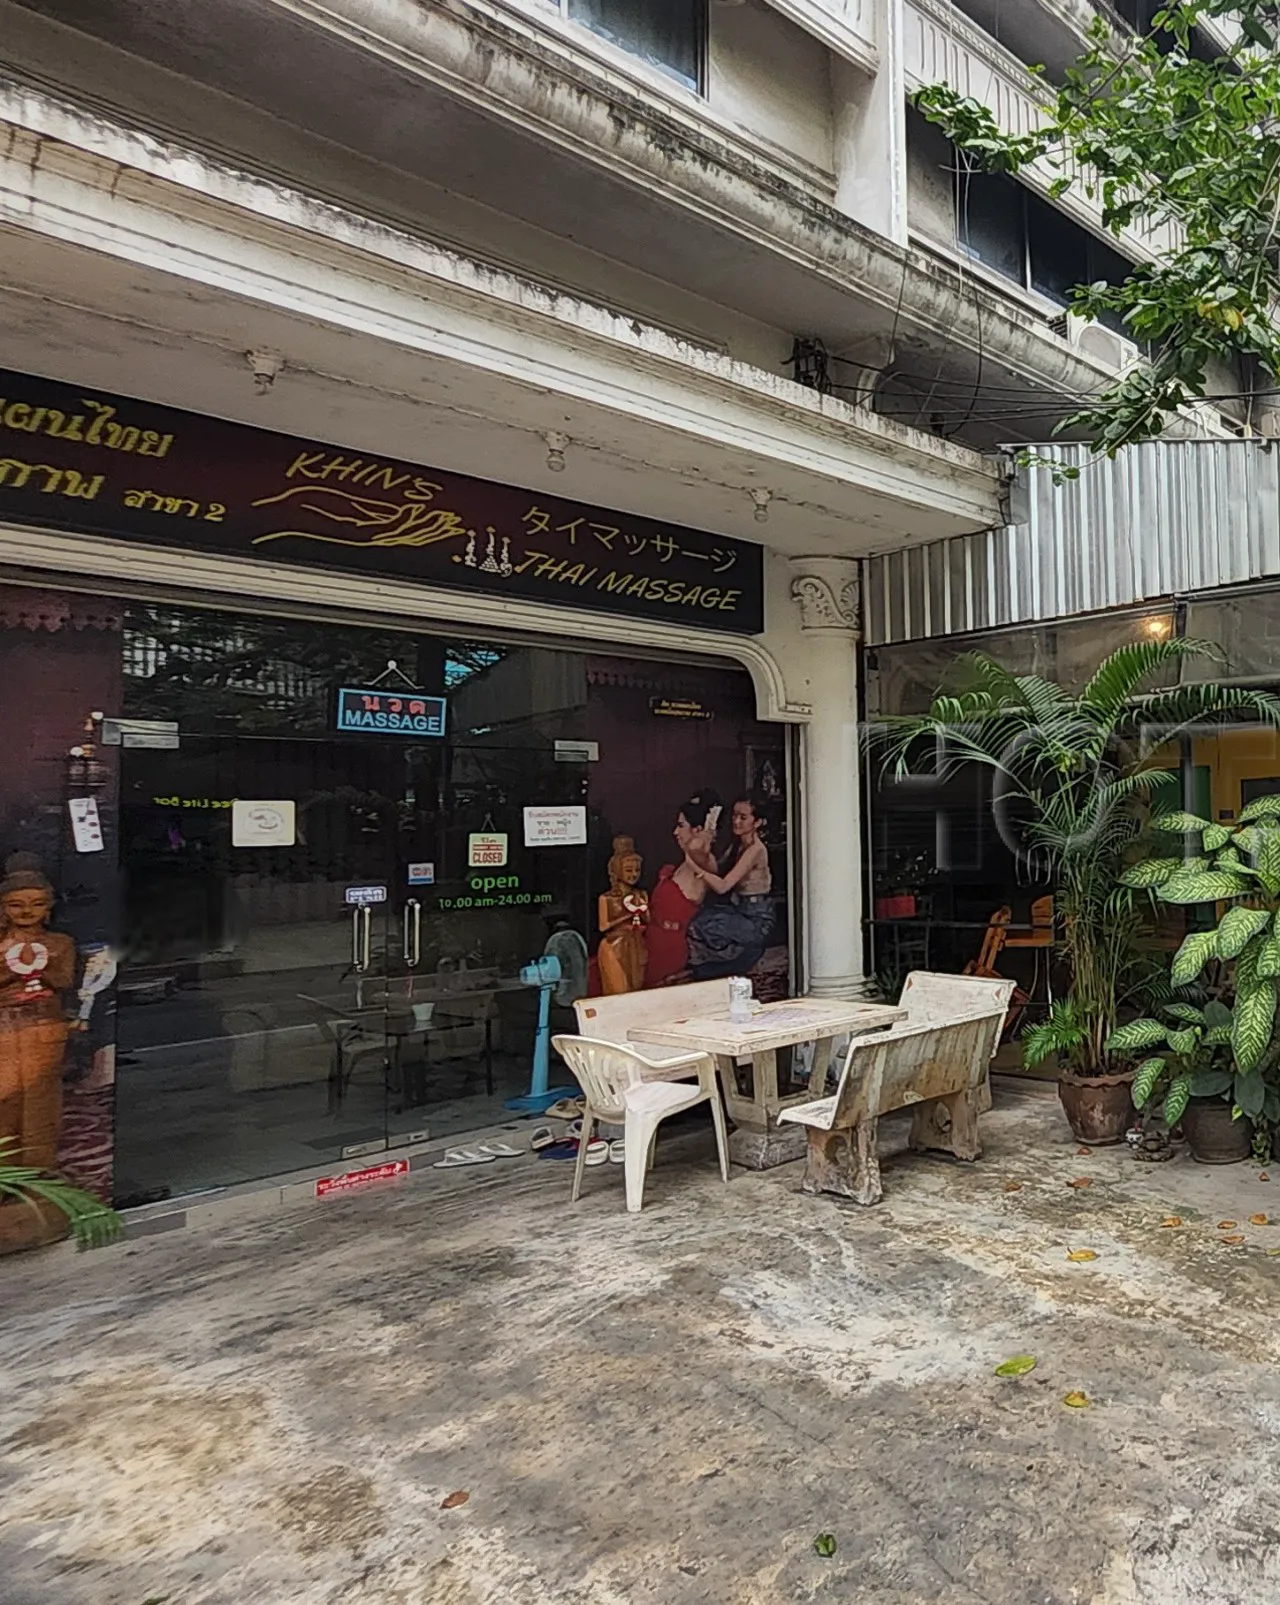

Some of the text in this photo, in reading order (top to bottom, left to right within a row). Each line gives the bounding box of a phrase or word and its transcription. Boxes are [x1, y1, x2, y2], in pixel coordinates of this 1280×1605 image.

[285, 452, 443, 501] KHIN'S
[124, 488, 199, 519] สาขา
[203, 503, 227, 523] 2
[521, 505, 738, 574] タイマッサージ
[513, 550, 742, 612] THAI MASSAGE
[344, 709, 441, 731] MASSAGE
[473, 852, 503, 864] CLOSED
[471, 875, 519, 893] open
[533, 893, 552, 903] am
